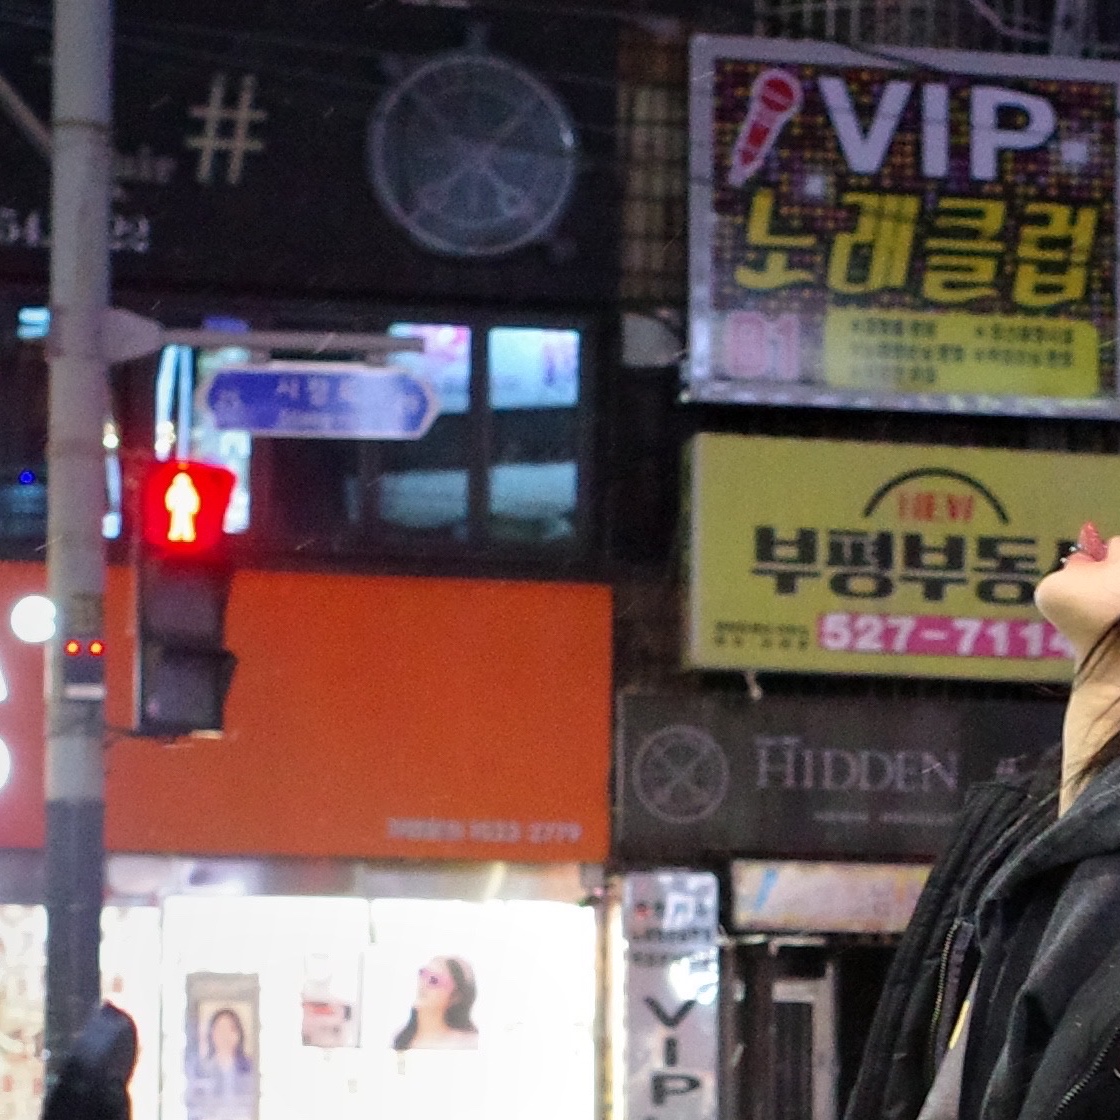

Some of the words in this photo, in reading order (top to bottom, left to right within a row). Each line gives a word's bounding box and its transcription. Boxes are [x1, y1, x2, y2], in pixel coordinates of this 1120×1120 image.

[817, 77, 1057, 180] VIP
[733, 189, 1097, 305] 노래클럽
[752, 525, 1077, 605] 부평부동
